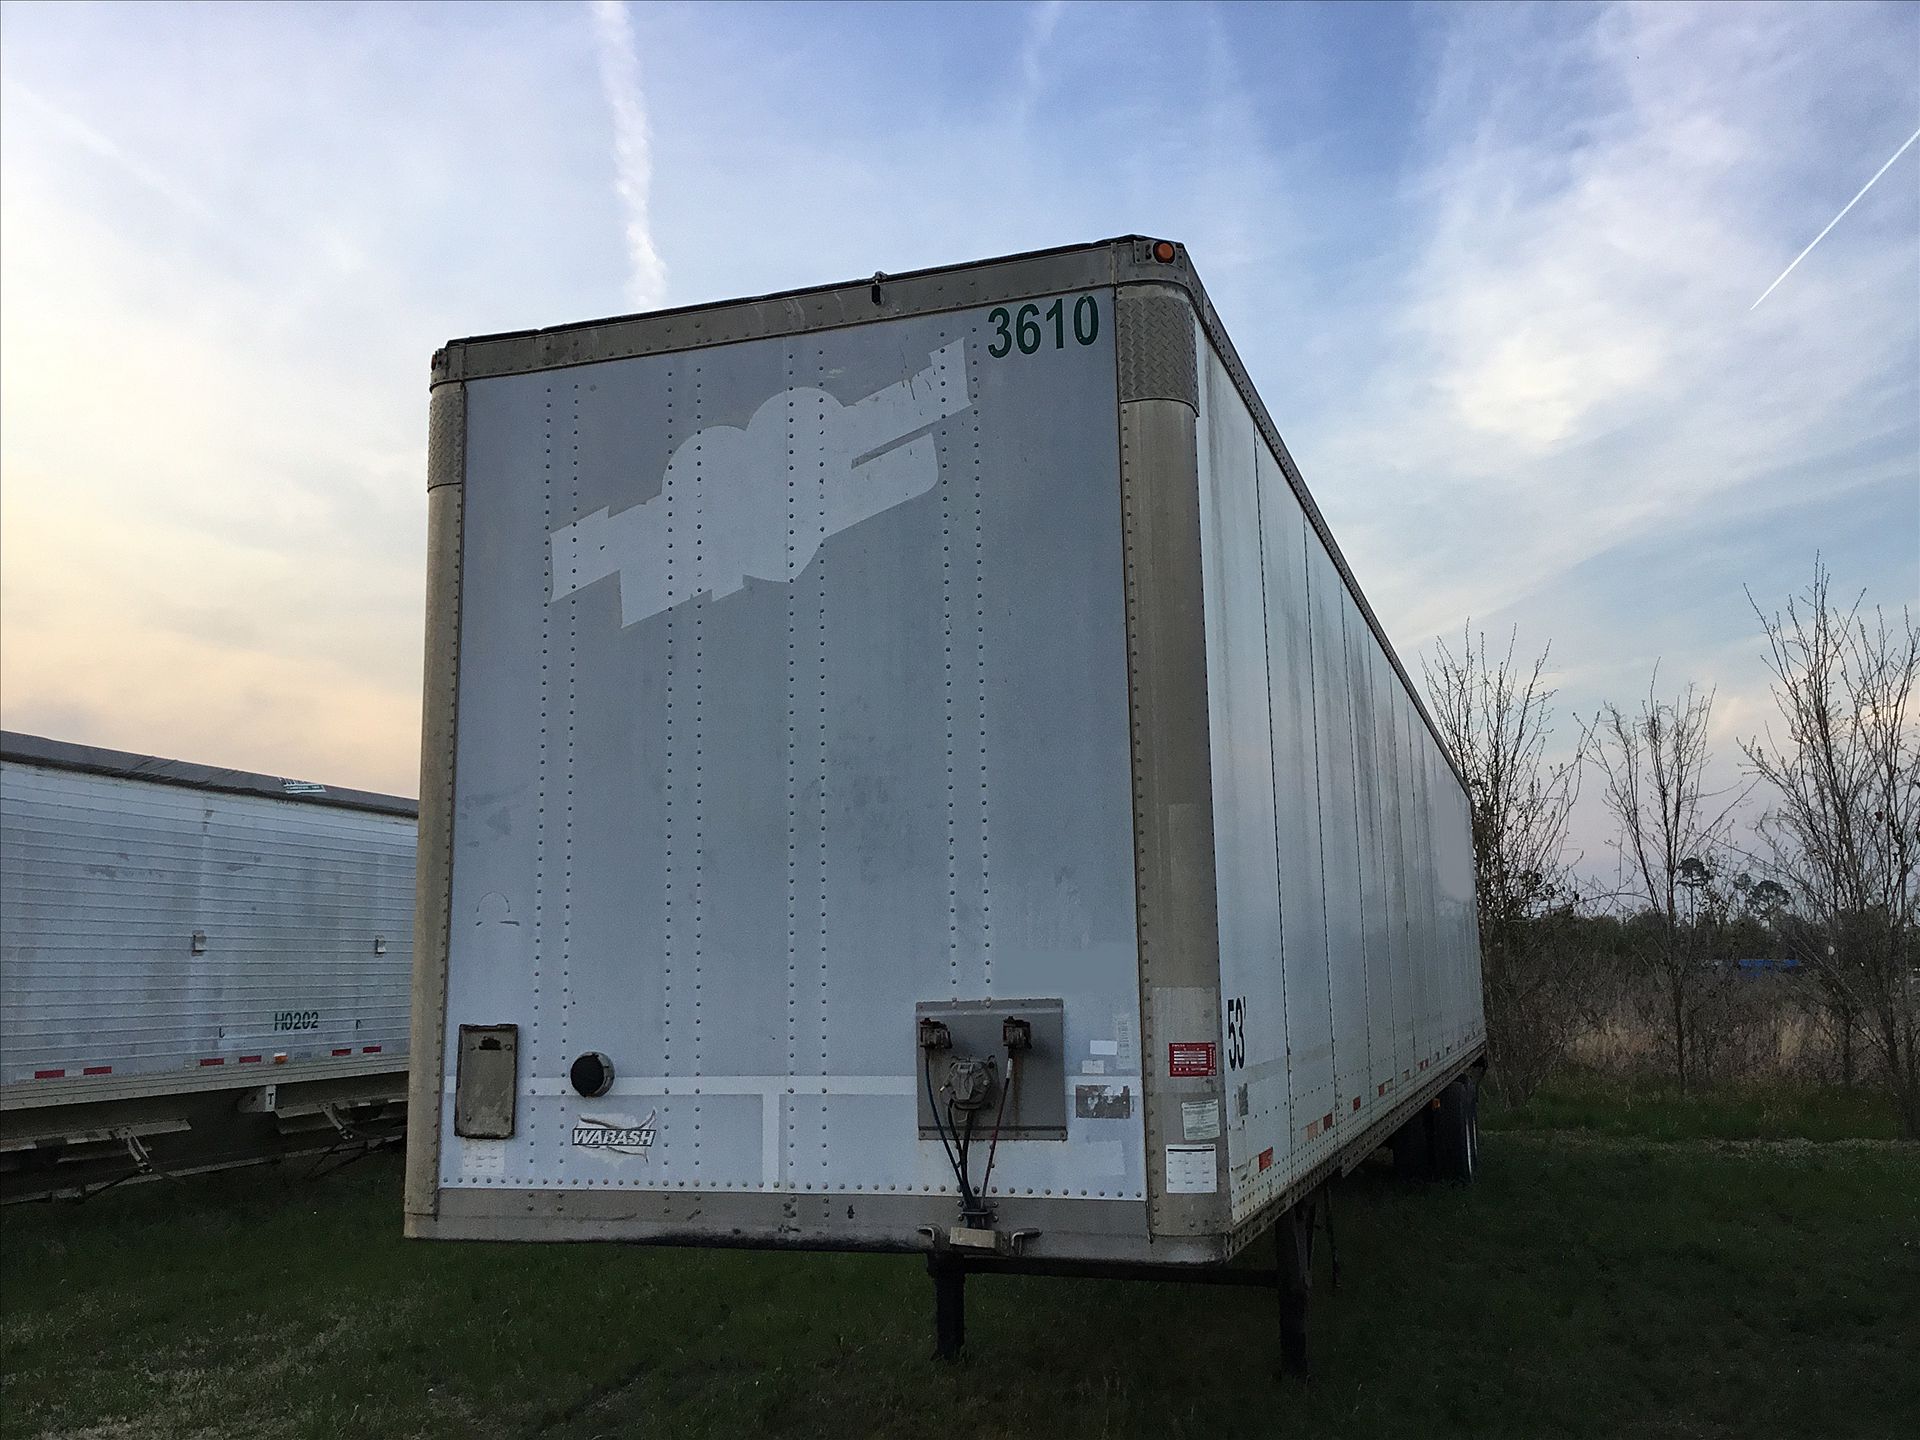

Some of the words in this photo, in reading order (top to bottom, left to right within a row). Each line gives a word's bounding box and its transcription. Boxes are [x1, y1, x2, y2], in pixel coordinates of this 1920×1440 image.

[988, 295, 1099, 358] 3610
[274, 1011, 319, 1031] H0202
[573, 1129, 655, 1145] WABASH
